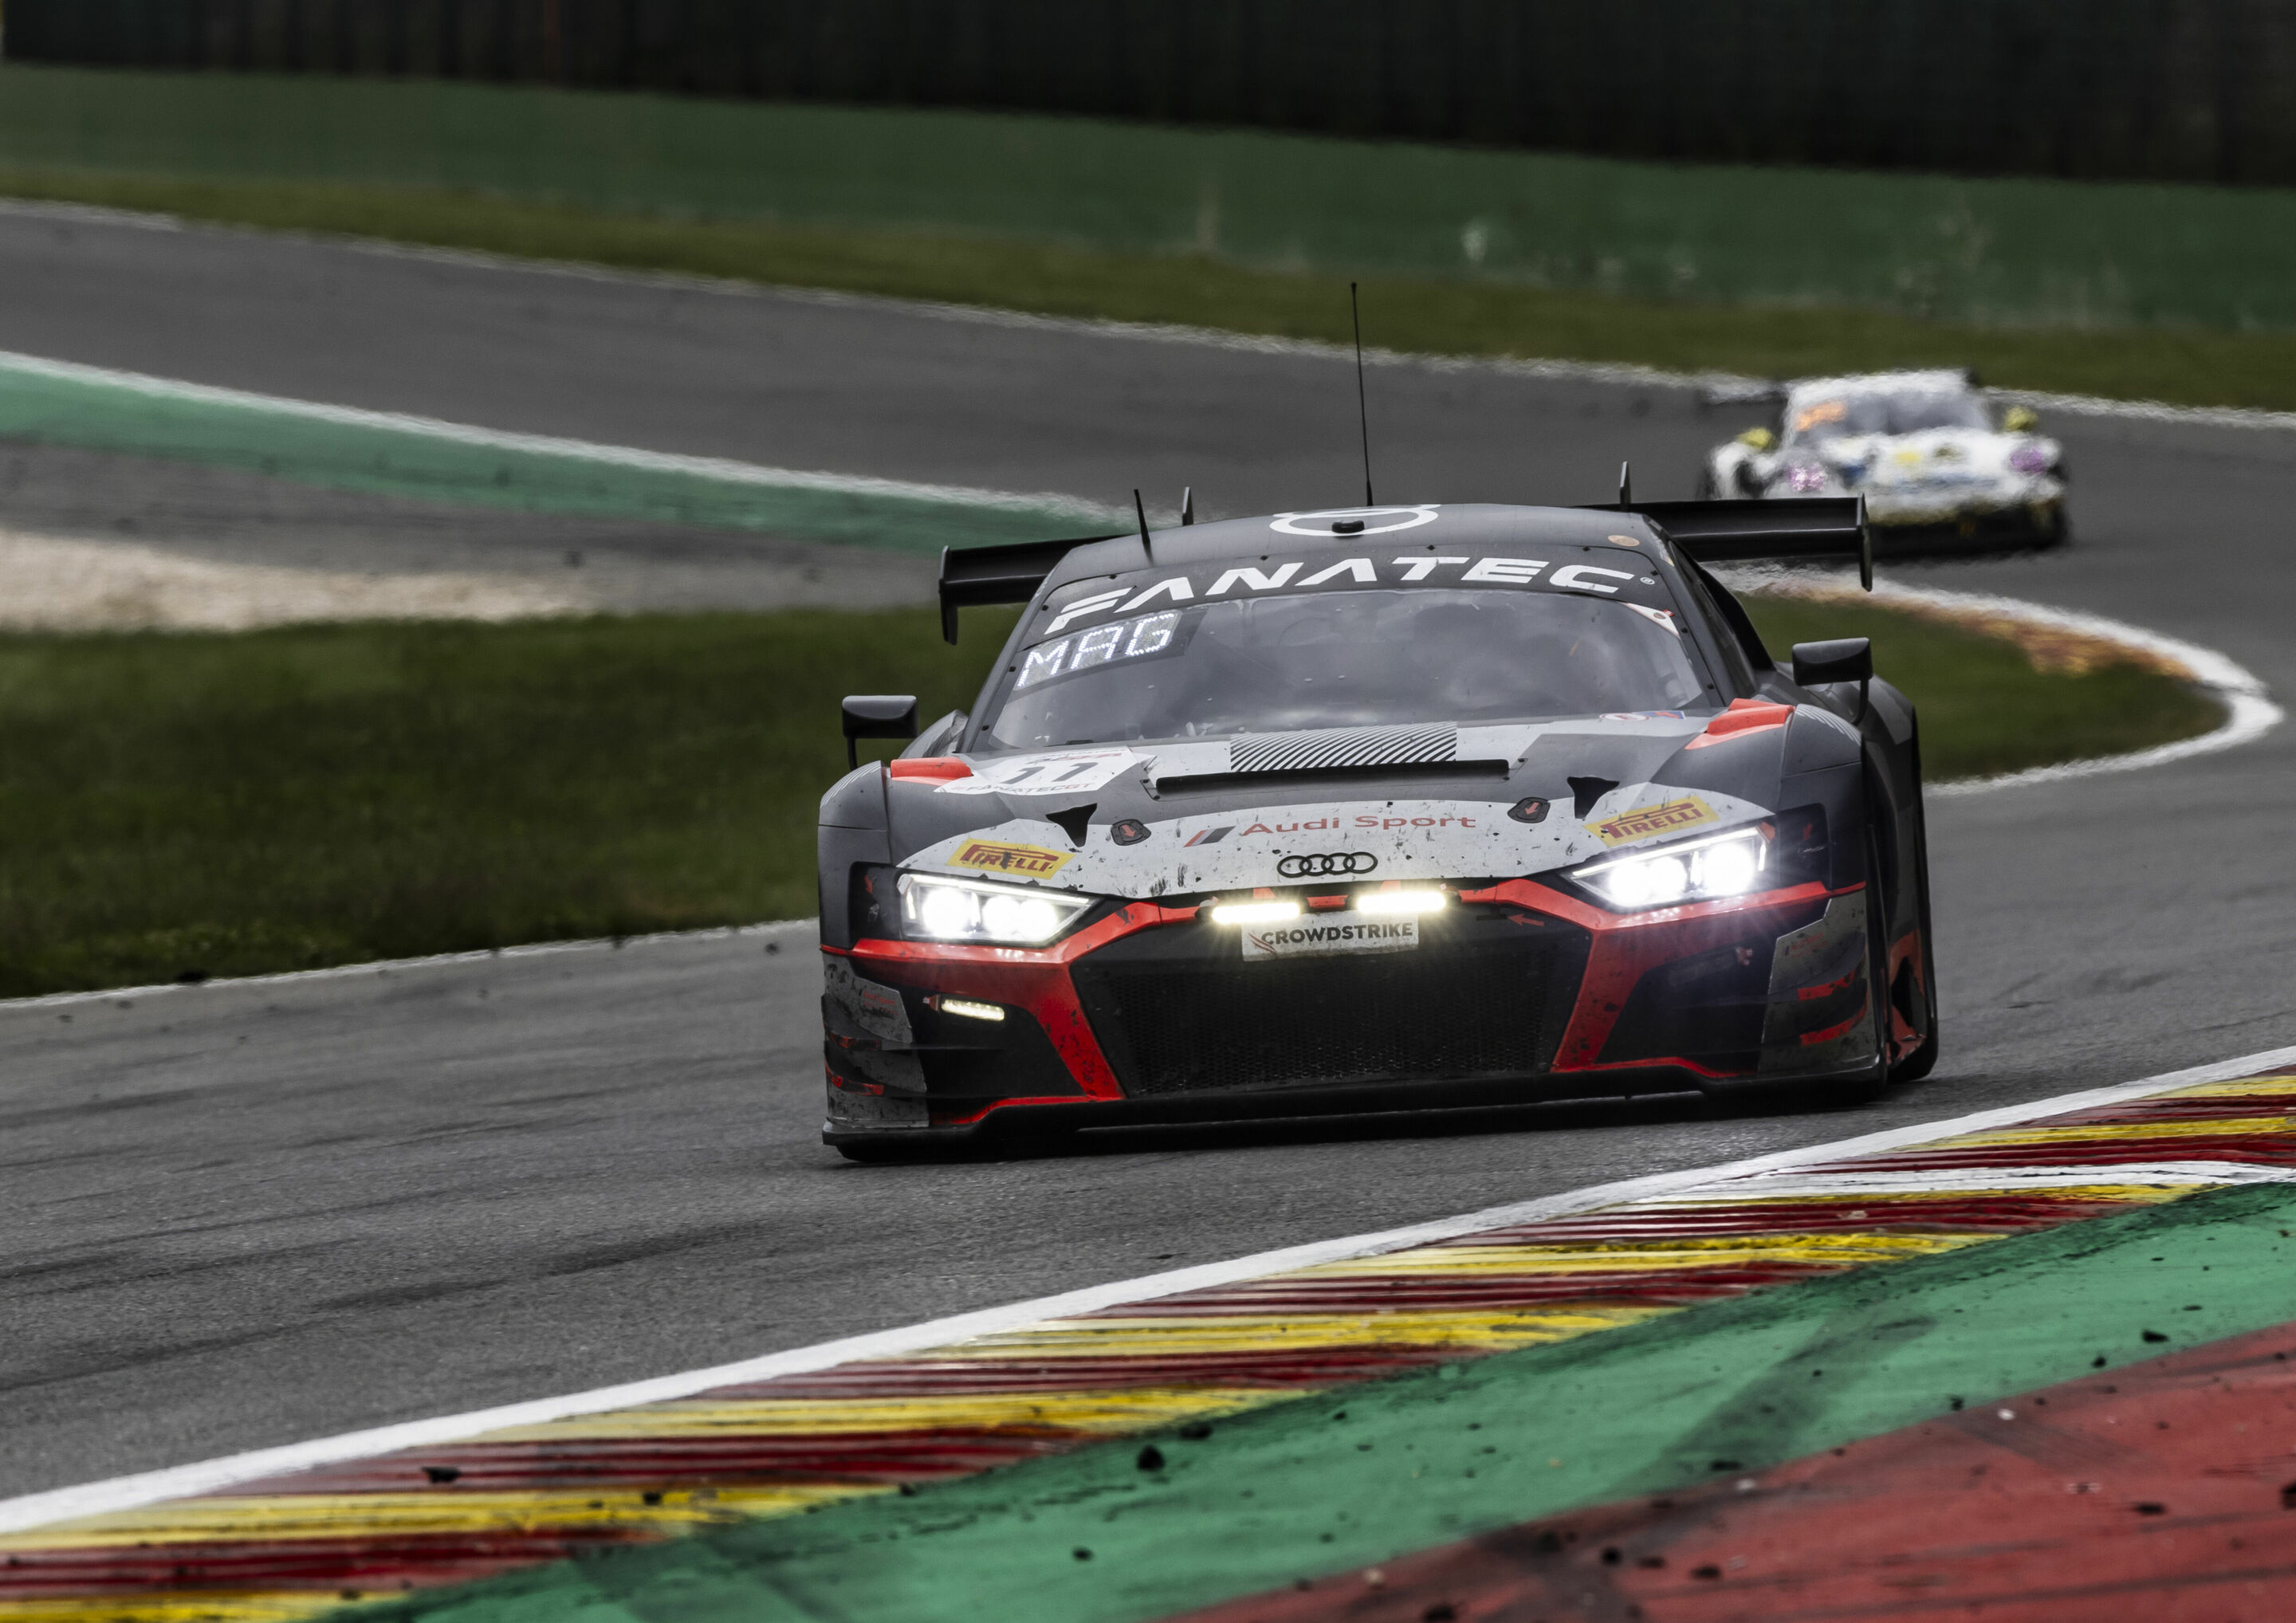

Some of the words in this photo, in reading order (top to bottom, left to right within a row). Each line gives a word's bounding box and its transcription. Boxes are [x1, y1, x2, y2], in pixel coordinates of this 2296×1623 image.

[1044, 556, 1635, 635] FANATEC
[1017, 613, 1174, 687] MAG
[1001, 762, 1099, 785] 11
[1241, 817, 1339, 836] Audi
[1354, 815, 1476, 830] Sport
[1599, 803, 1704, 839] PIRELLI
[959, 843, 1060, 872] PIRELLI
[1261, 922, 1413, 945] CROWDSTRIKE
